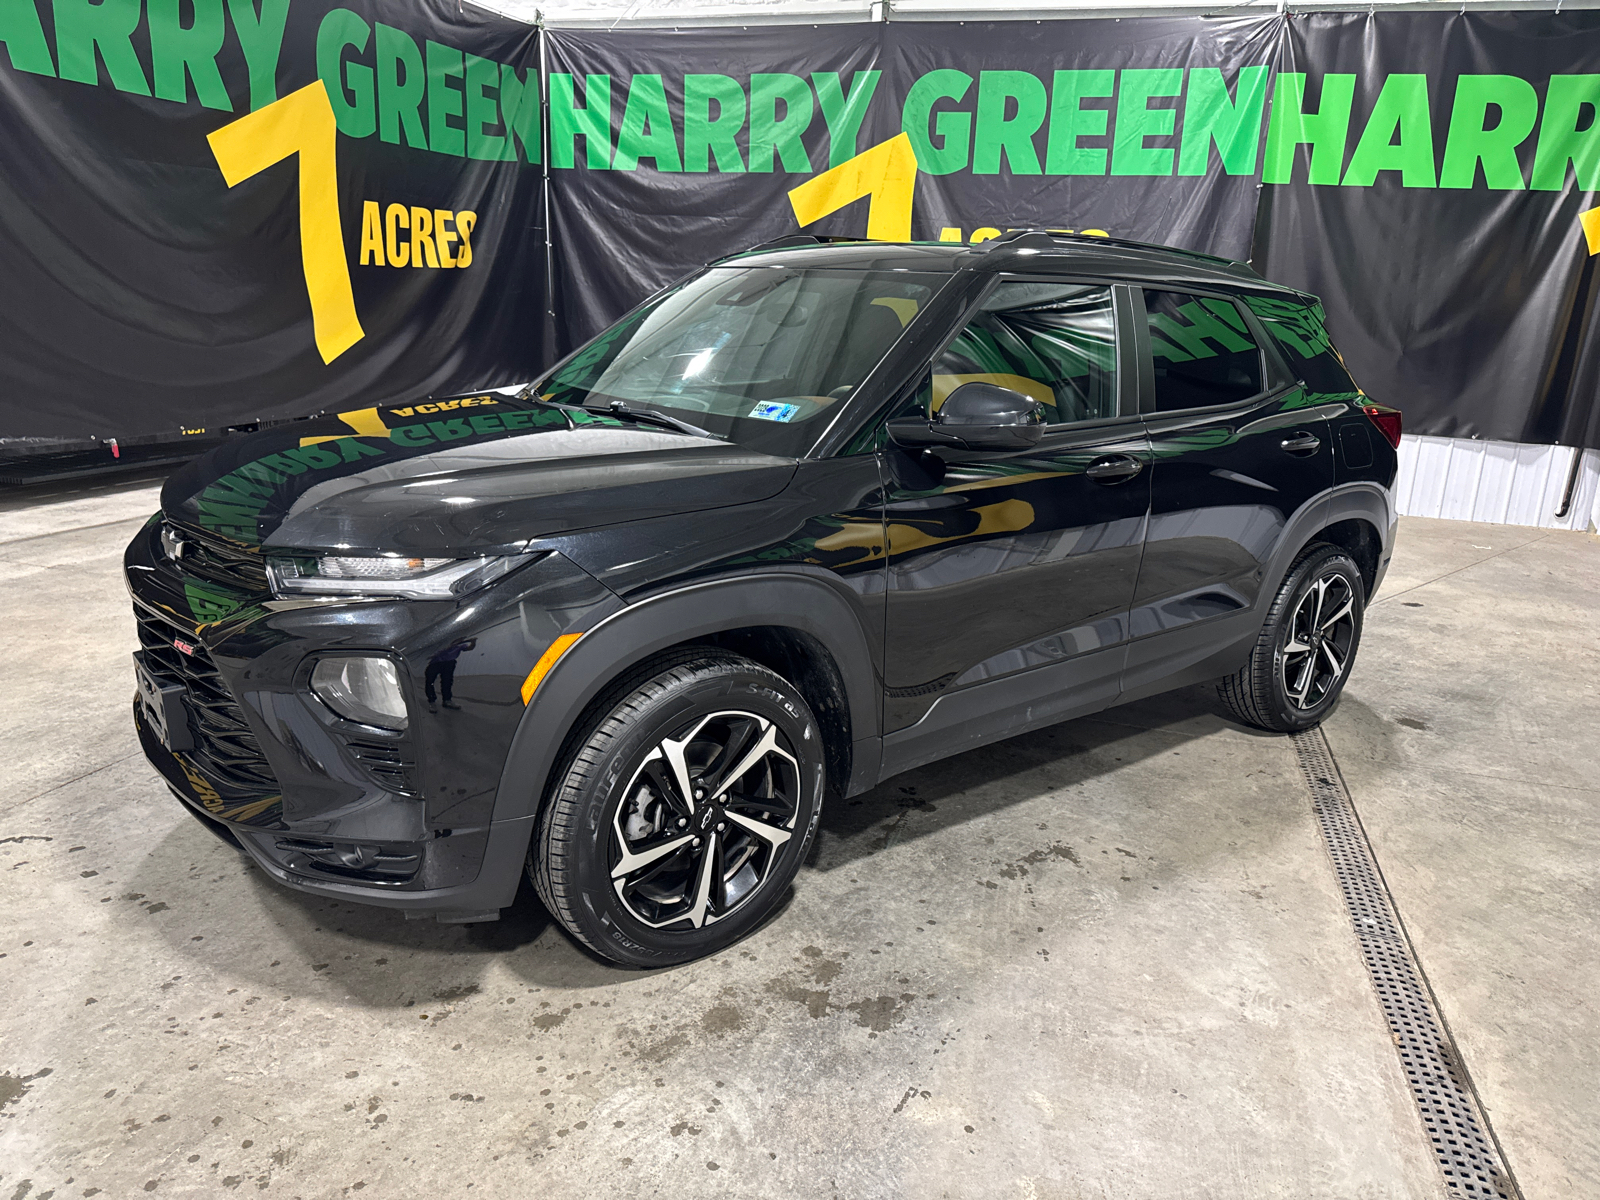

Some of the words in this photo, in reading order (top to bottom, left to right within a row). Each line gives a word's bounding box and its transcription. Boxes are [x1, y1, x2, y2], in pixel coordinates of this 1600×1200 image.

[316, 8, 541, 165] GREEN
[549, 70, 882, 173] HARRY
[902, 65, 1269, 176] GREEN
[1262, 72, 1600, 191] HARR
[206, 79, 365, 365] 7
[360, 200, 477, 269] ACRES
[173, 639, 194, 656] RS
[761, 687, 785, 703] FIT
